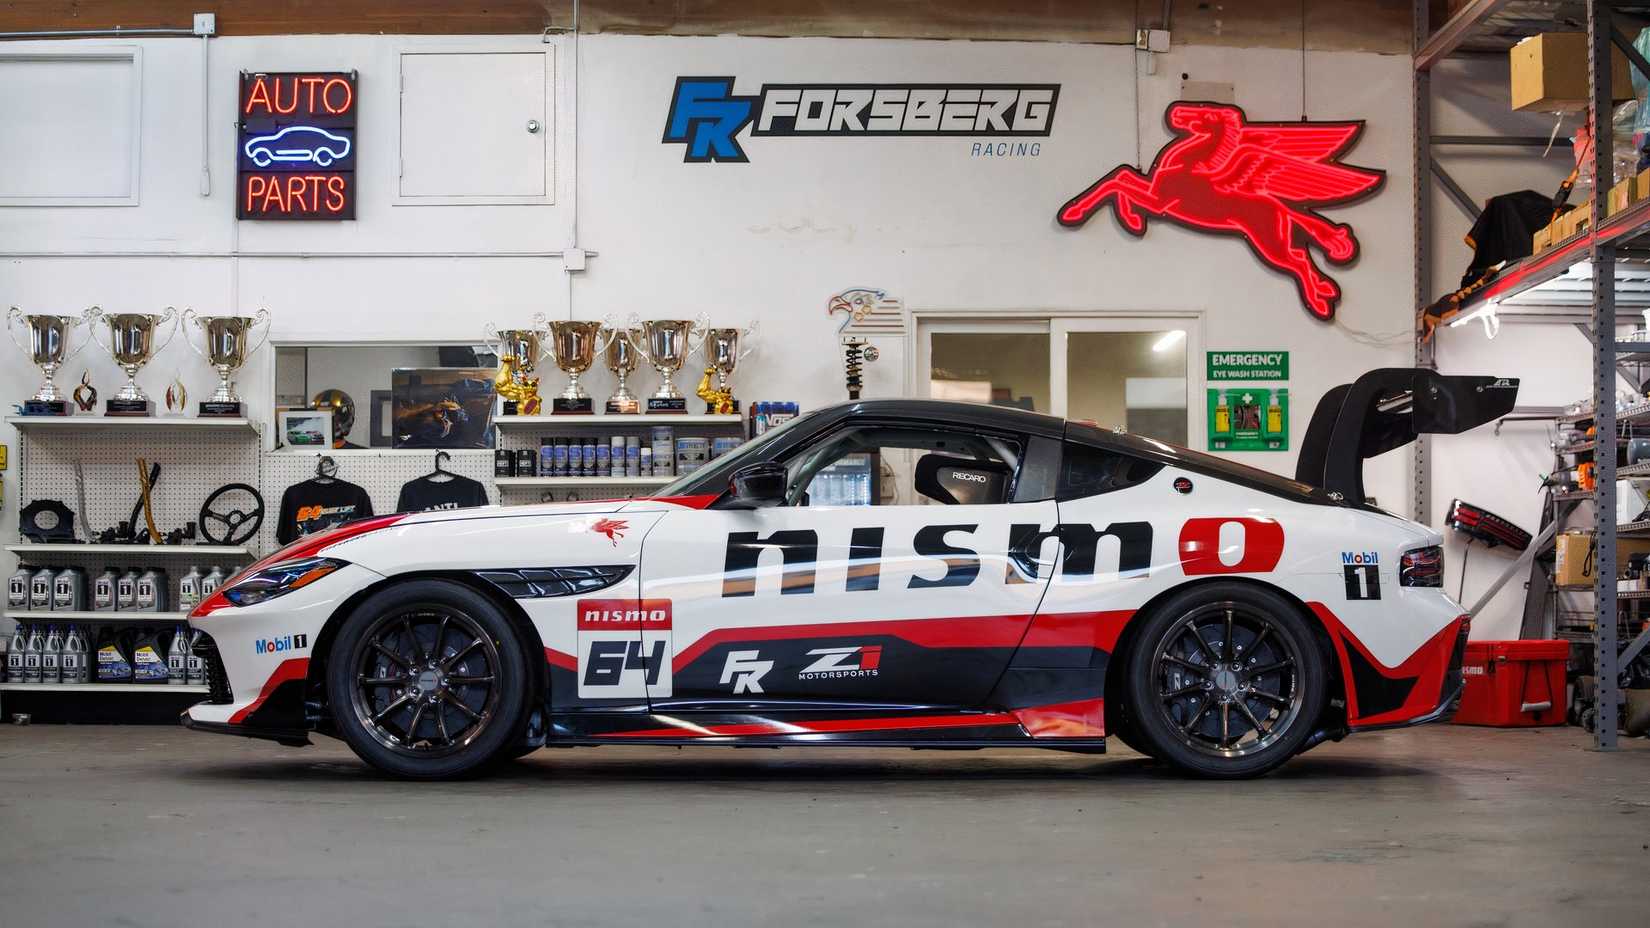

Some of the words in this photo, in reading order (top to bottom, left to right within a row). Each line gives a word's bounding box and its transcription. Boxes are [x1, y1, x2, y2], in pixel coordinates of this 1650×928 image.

[246, 77, 352, 113] AUTO
[758, 88, 1055, 132] FORSBERG
[970, 142, 1042, 157] RACING
[247, 176, 346, 212] PARTS
[1212, 354, 1283, 366] EMERGENCY
[1213, 370, 1226, 378] EYE
[1228, 370, 1250, 378] WASH
[1251, 370, 1281, 378] STATION
[952, 471, 986, 483] RECARO
[1341, 551, 1379, 564] Mobil
[255, 636, 291, 655] Mobil
[584, 640, 667, 686] 64
[799, 645, 882, 674] Z1
[719, 650, 775, 694] FR
[798, 669, 879, 680] MOTORSPORTS
